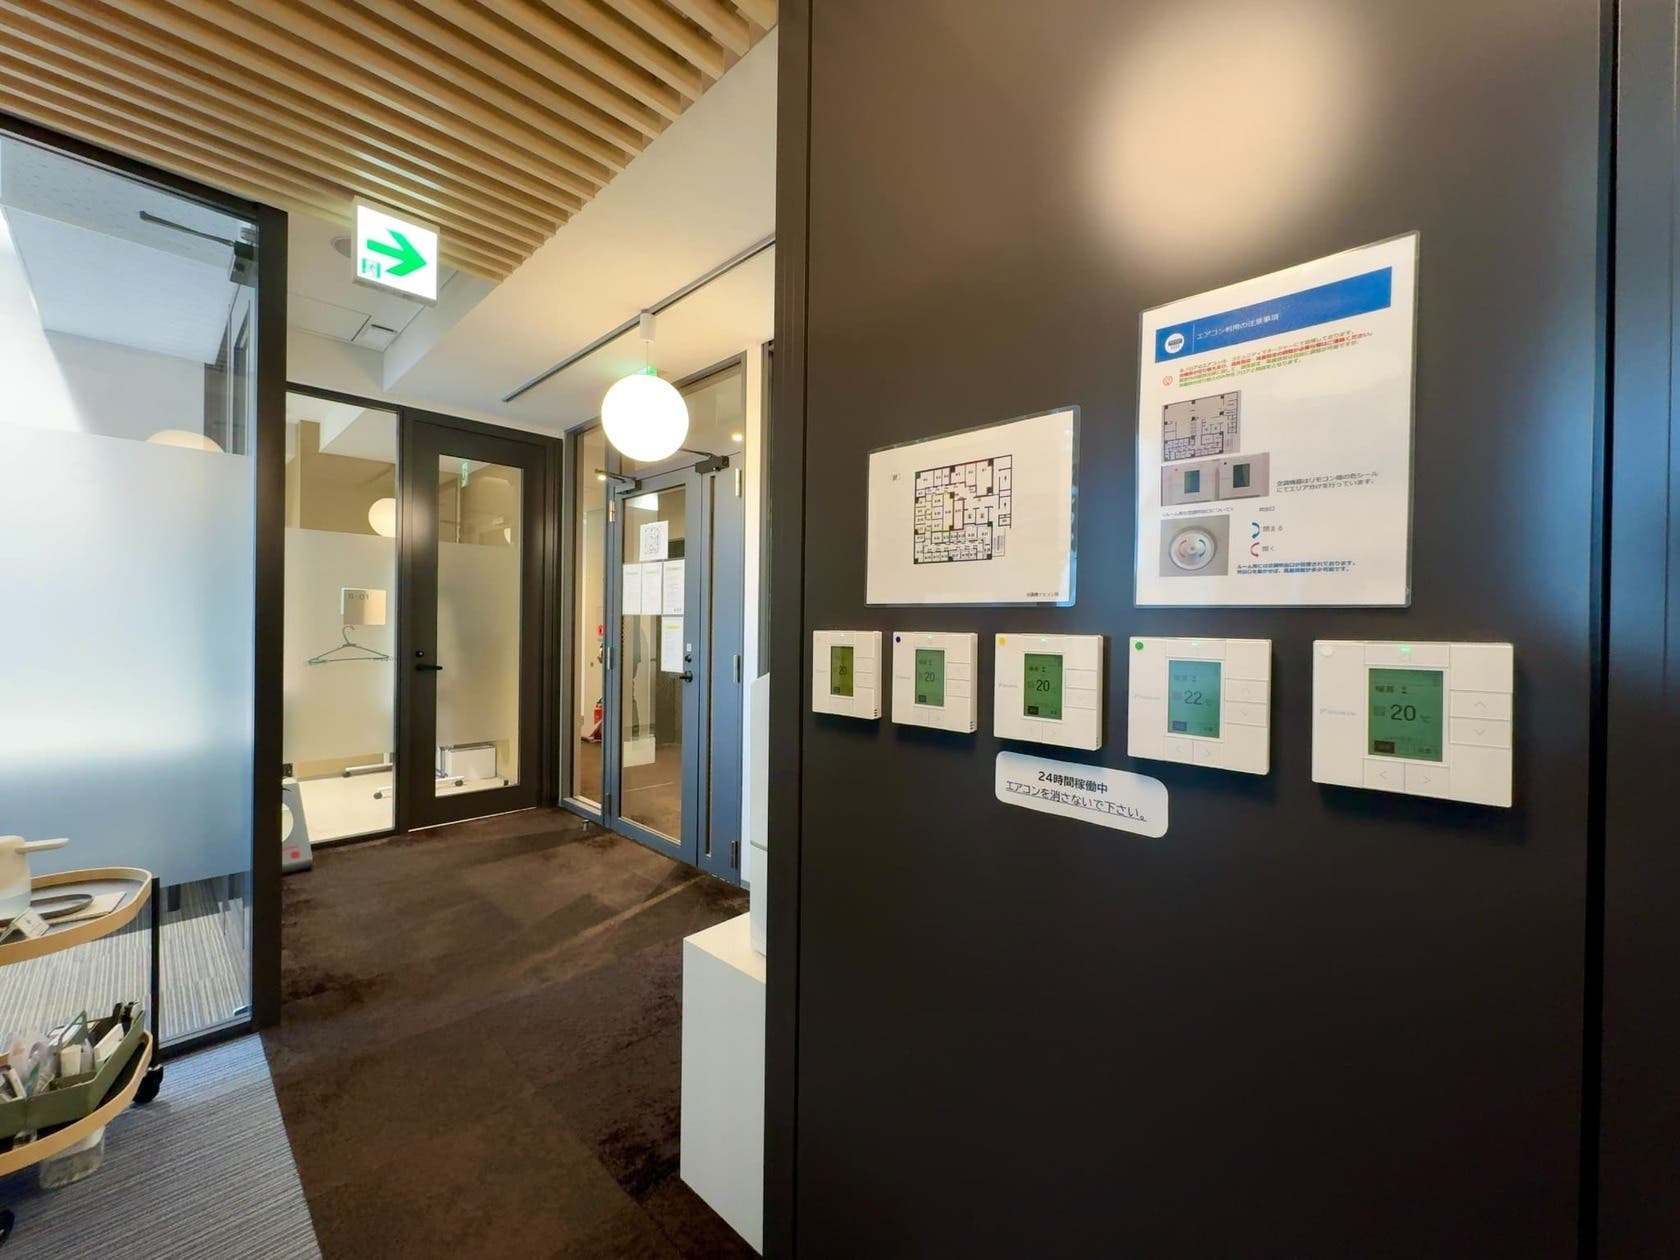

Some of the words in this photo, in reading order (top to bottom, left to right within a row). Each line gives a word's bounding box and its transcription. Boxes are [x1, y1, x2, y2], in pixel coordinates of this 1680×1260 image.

[925, 671, 936, 682] 20
[1036, 679, 1050, 692] 20
[1184, 689, 1202, 705] 22
[1390, 703, 1417, 722] 20
[1037, 770, 1108, 795] 24時間稼働中
[1006, 780, 1147, 822] エアコンを消さないで下さい。
